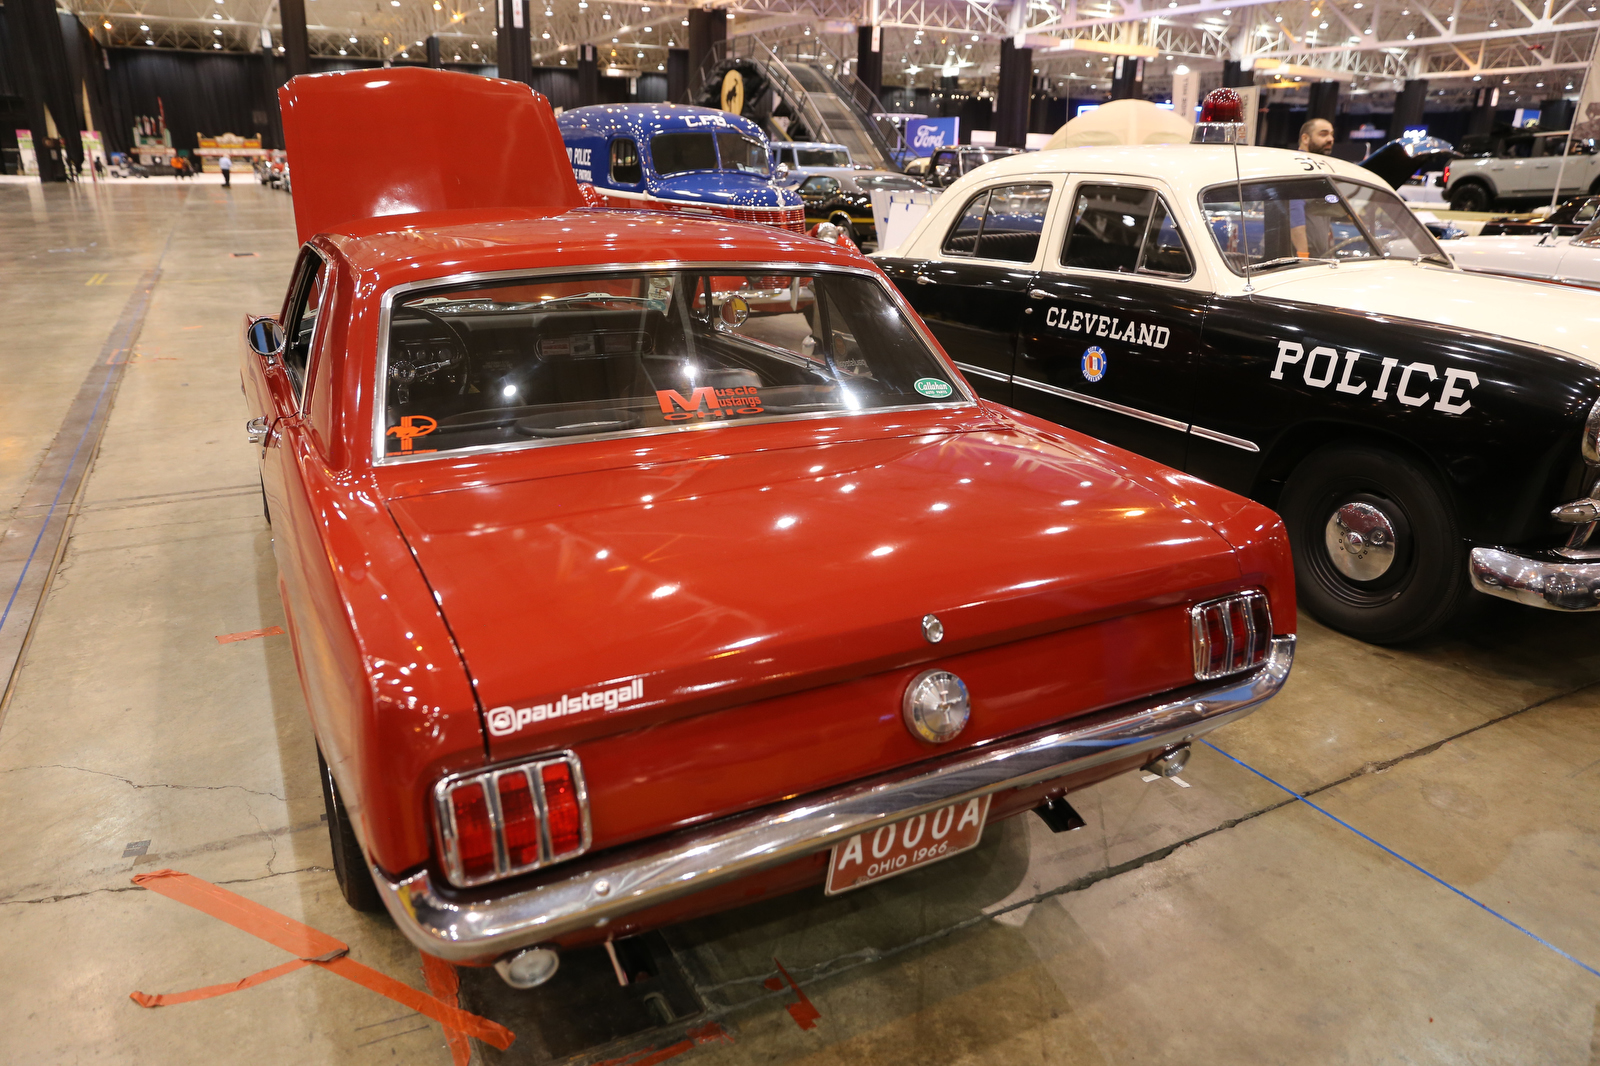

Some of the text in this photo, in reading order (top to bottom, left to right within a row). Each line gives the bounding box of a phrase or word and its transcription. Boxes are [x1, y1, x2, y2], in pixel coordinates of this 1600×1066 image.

[914, 125, 945, 148] Ford
[574, 148, 592, 166] POLICE
[1046, 306, 1170, 349] CLEVELAND
[1270, 340, 1480, 415] POLICE
[663, 406, 765, 420] OHIO
[487, 678, 644, 737] @paulstegall
[867, 840, 949, 877] OHIO 1966
